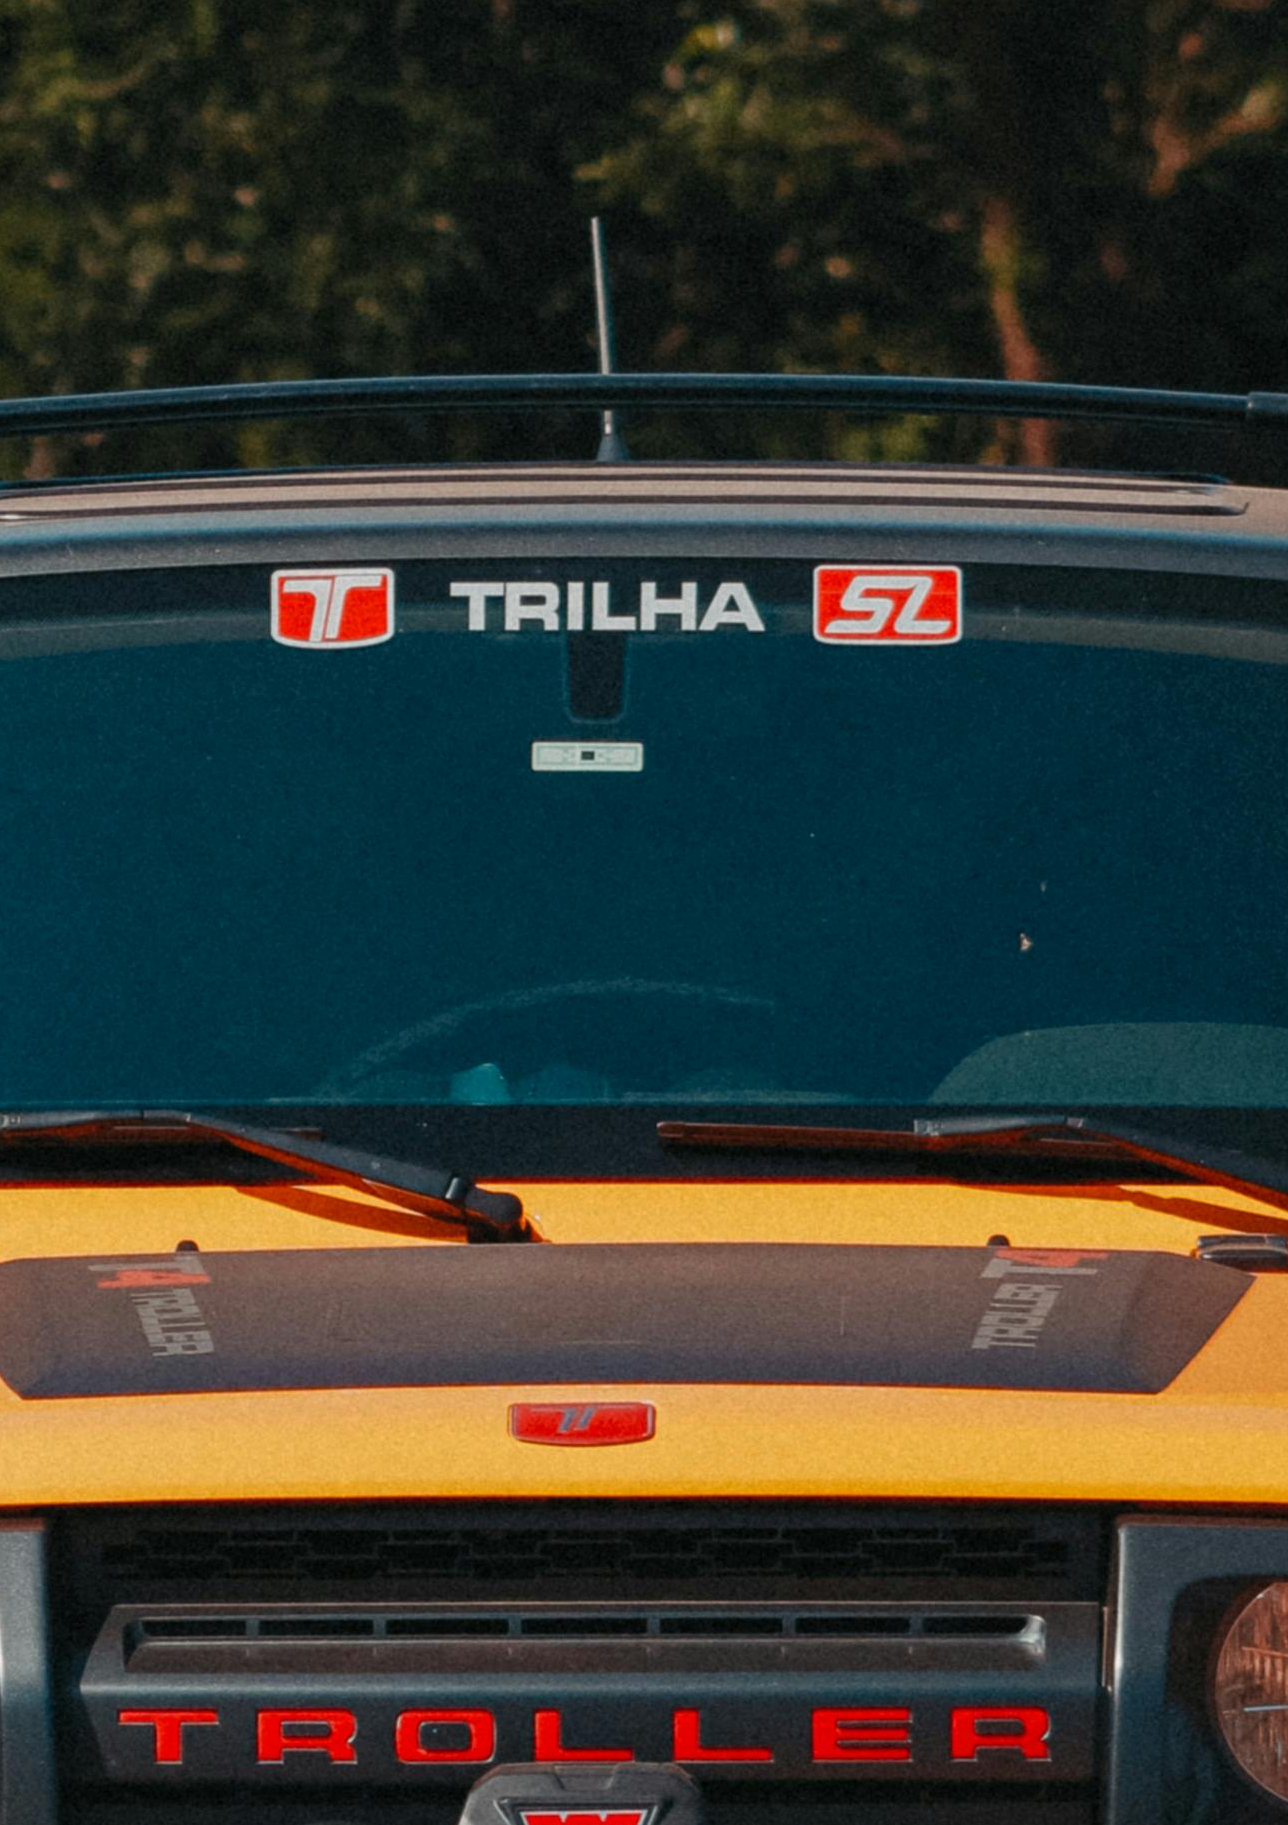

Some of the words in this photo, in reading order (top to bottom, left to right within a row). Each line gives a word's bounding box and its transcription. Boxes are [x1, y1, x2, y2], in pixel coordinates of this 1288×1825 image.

[449, 581, 766, 632] TRILHA
[130, 1287, 215, 1357] TROLLER
[971, 1282, 1064, 1350] TROLLER
[118, 1707, 1053, 1765] TROLLER
